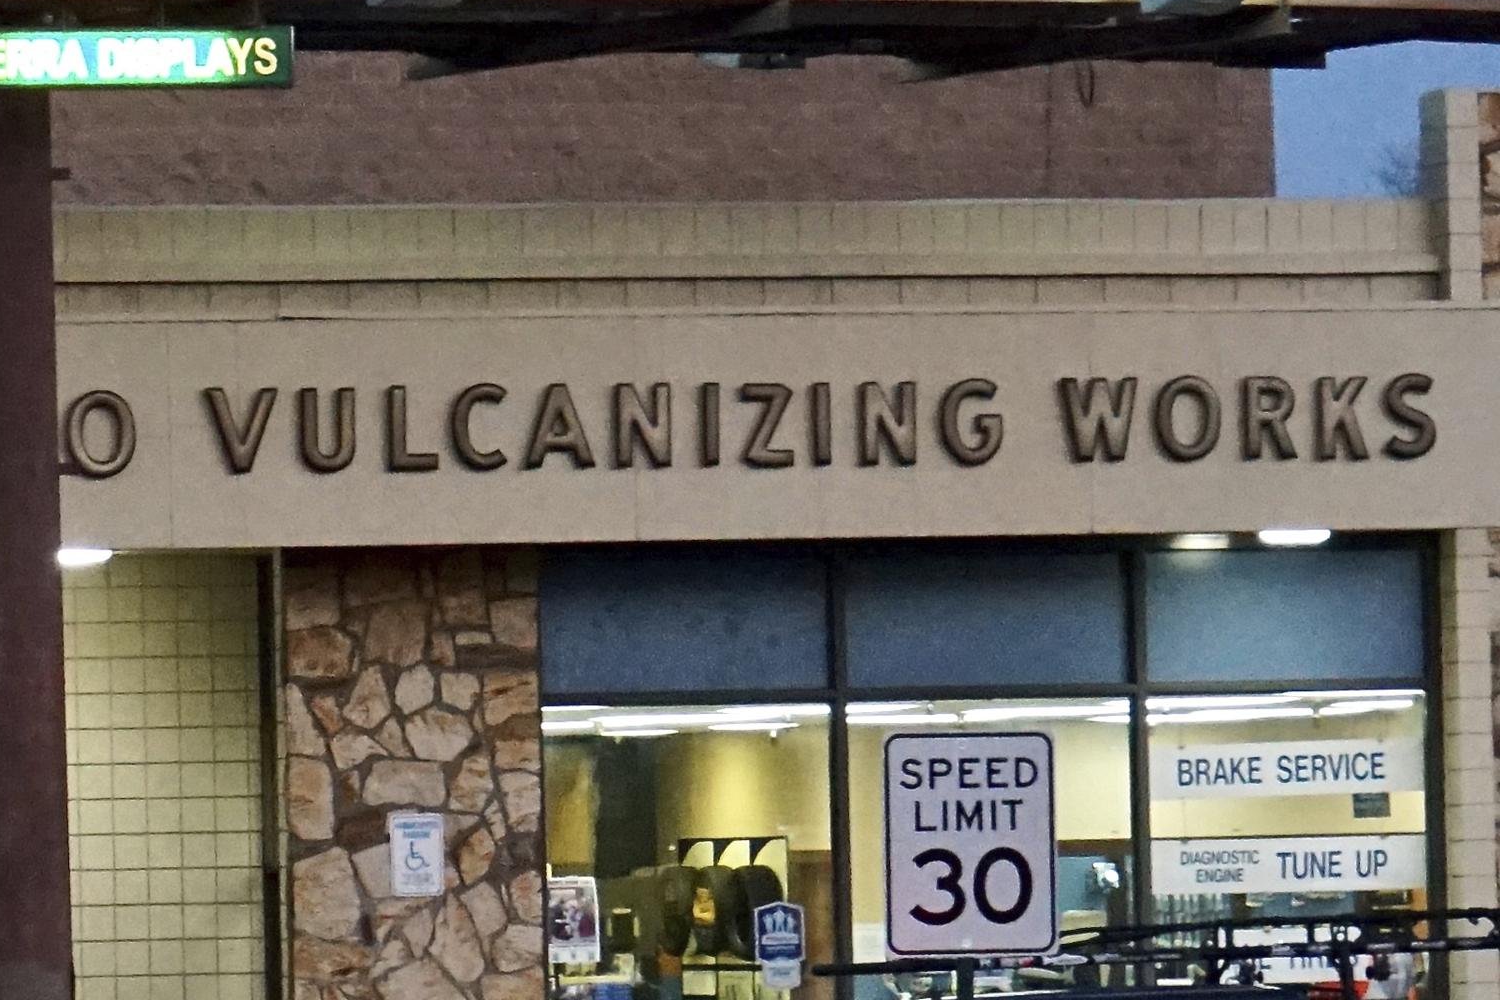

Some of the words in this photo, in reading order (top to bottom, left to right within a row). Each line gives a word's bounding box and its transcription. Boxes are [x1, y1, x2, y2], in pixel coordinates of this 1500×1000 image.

[98, 37, 278, 78] DISPLAYS
[203, 377, 1005, 476] VULCANIZING
[1056, 371, 1439, 466] WORKS
[899, 756, 1039, 790] SPEED
[1177, 755, 1263, 788] BRAKE
[1276, 751, 1386, 784] SERVICE
[913, 798, 1024, 833] LIMIT
[1180, 849, 1260, 867] DIAGNOSTIC
[1276, 850, 1343, 880] TUNE
[1356, 849, 1389, 878] UP
[908, 845, 1034, 926] 30
[1195, 868, 1244, 884] ENGINE
